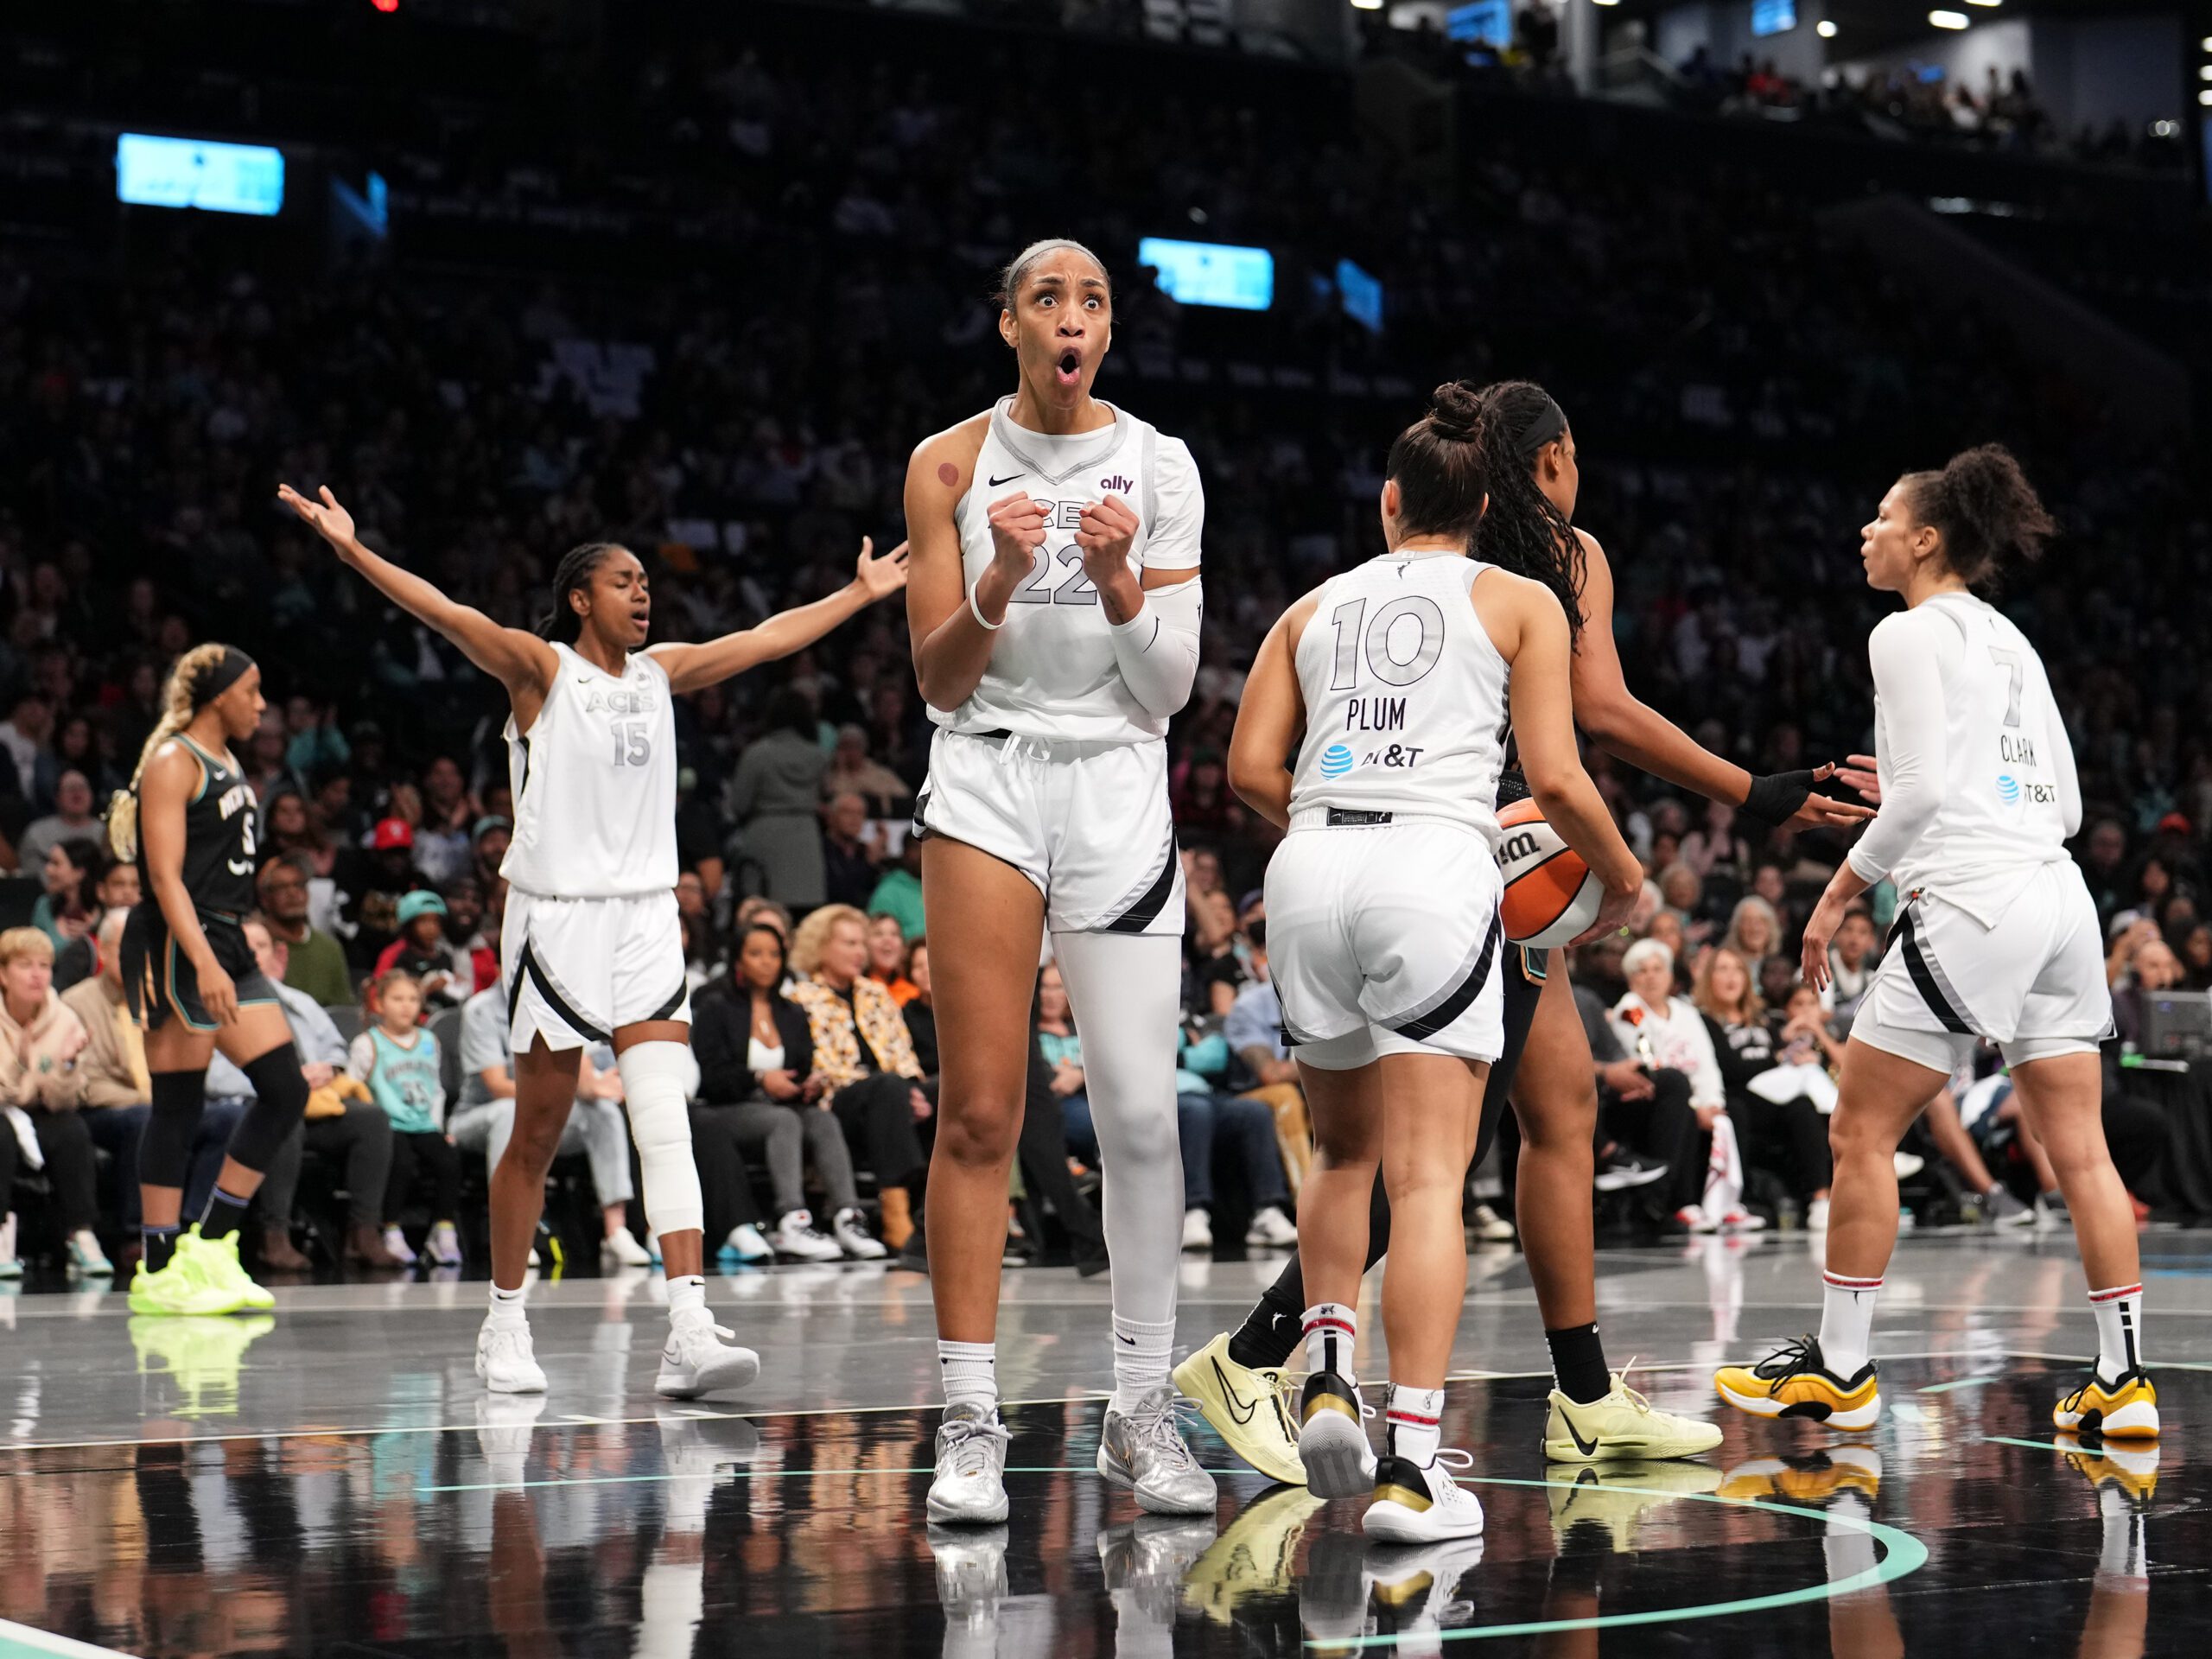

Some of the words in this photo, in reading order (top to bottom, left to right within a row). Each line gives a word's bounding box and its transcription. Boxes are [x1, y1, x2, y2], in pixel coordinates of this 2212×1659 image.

[1100, 475, 1134, 494] ally
[1008, 543, 1097, 605] 22
[1330, 595, 1445, 690] 10
[1987, 645, 2023, 728] 7
[1346, 697, 1407, 731] PLUM
[611, 722, 651, 766] 15
